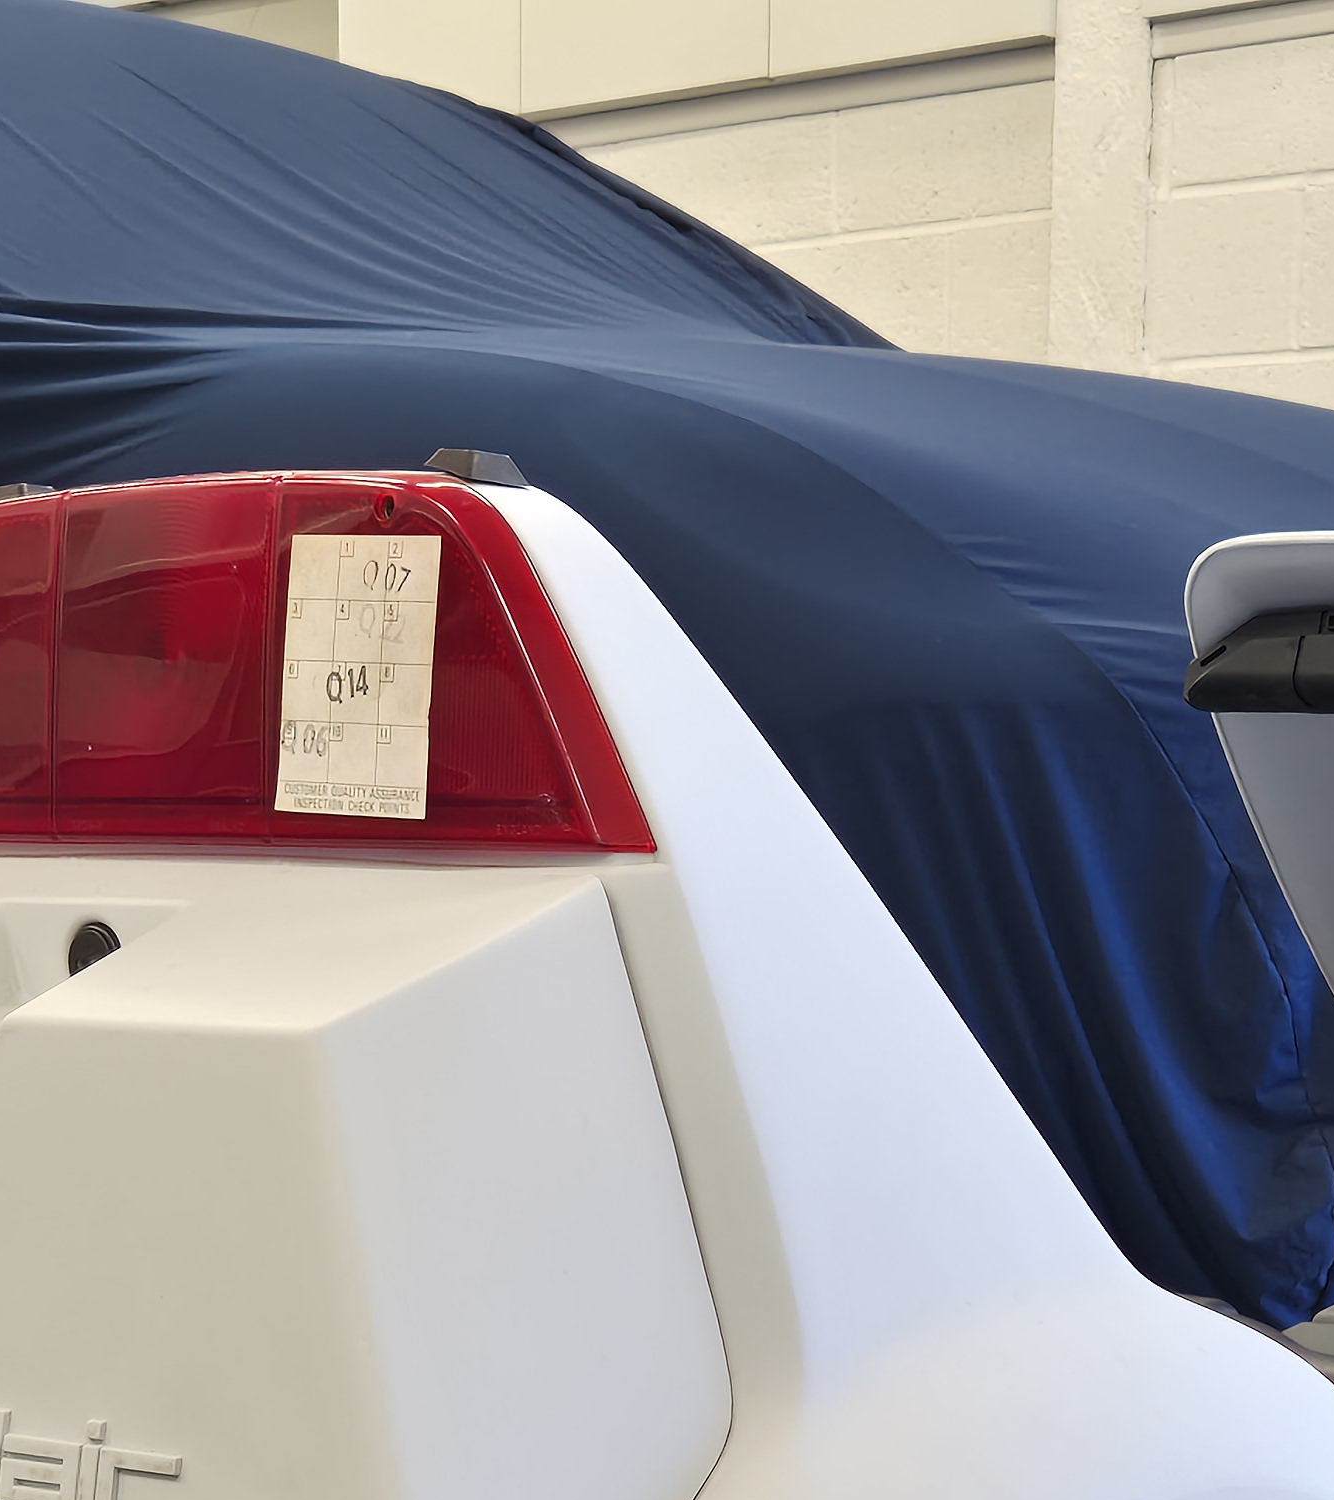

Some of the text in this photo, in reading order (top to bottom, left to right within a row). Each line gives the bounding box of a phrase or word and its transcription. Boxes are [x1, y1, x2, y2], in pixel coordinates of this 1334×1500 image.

[392, 542, 399, 555] 2
[326, 665, 369, 704] Q14
[284, 782, 420, 802] CUSTOMER QUALITY ASSURANCE
[293, 797, 344, 811] INSPECTION
[348, 799, 375, 812] CHECK
